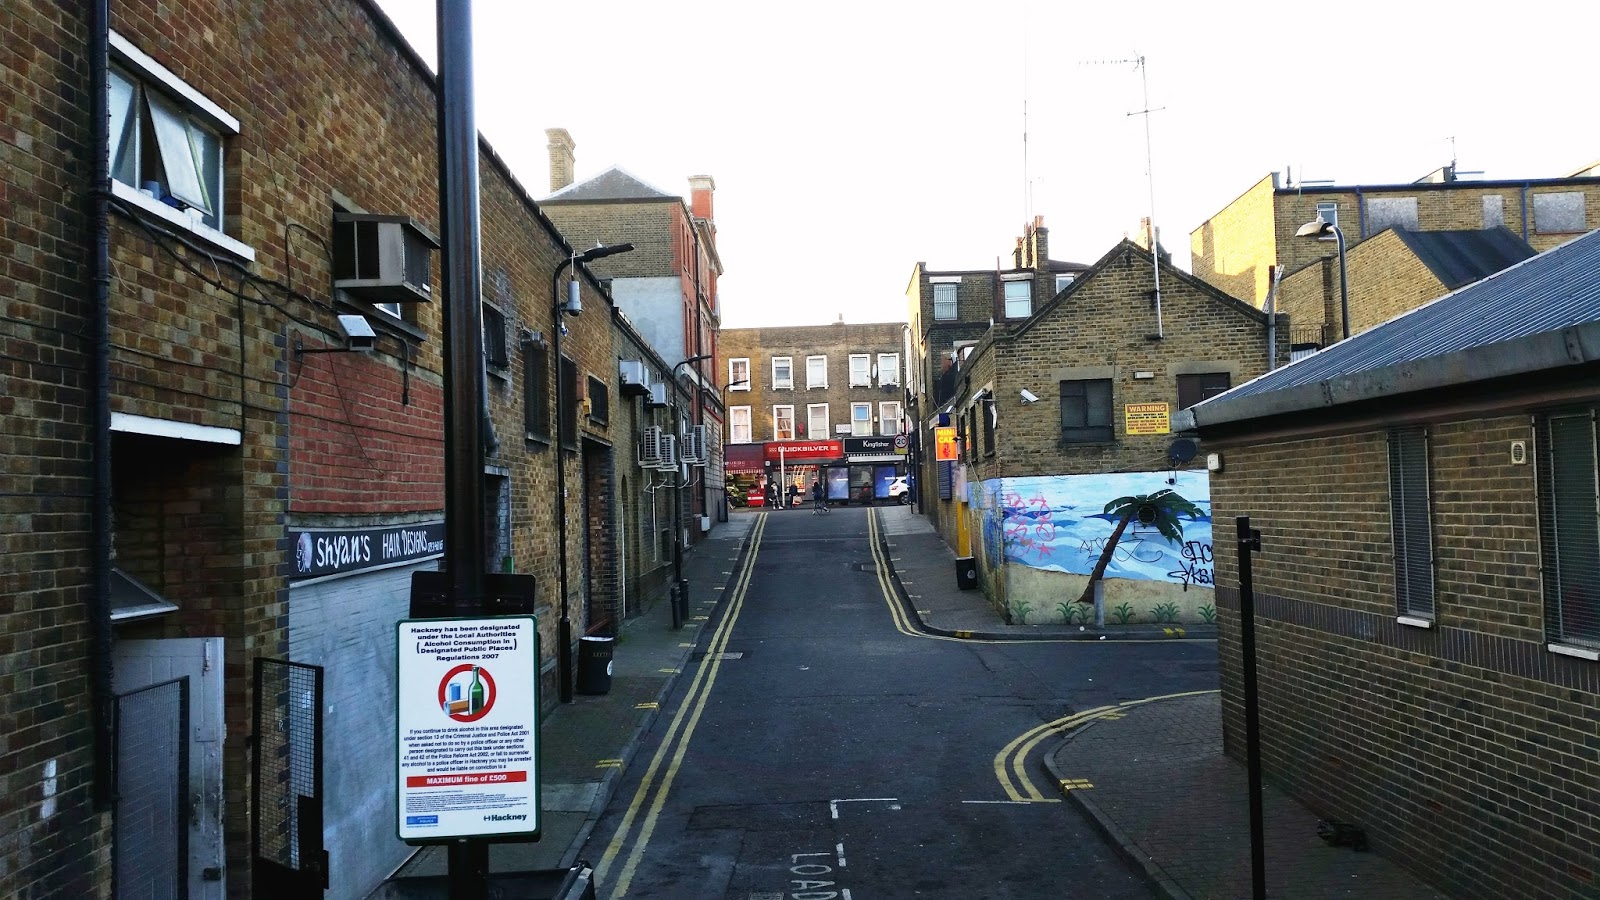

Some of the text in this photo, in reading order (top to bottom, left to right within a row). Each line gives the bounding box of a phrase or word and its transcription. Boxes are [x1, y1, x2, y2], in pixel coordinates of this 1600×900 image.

[383, 532, 402, 559] HAIR
[402, 529, 427, 556] DESIGNS
[427, 777, 462, 785] MAXIMUM
